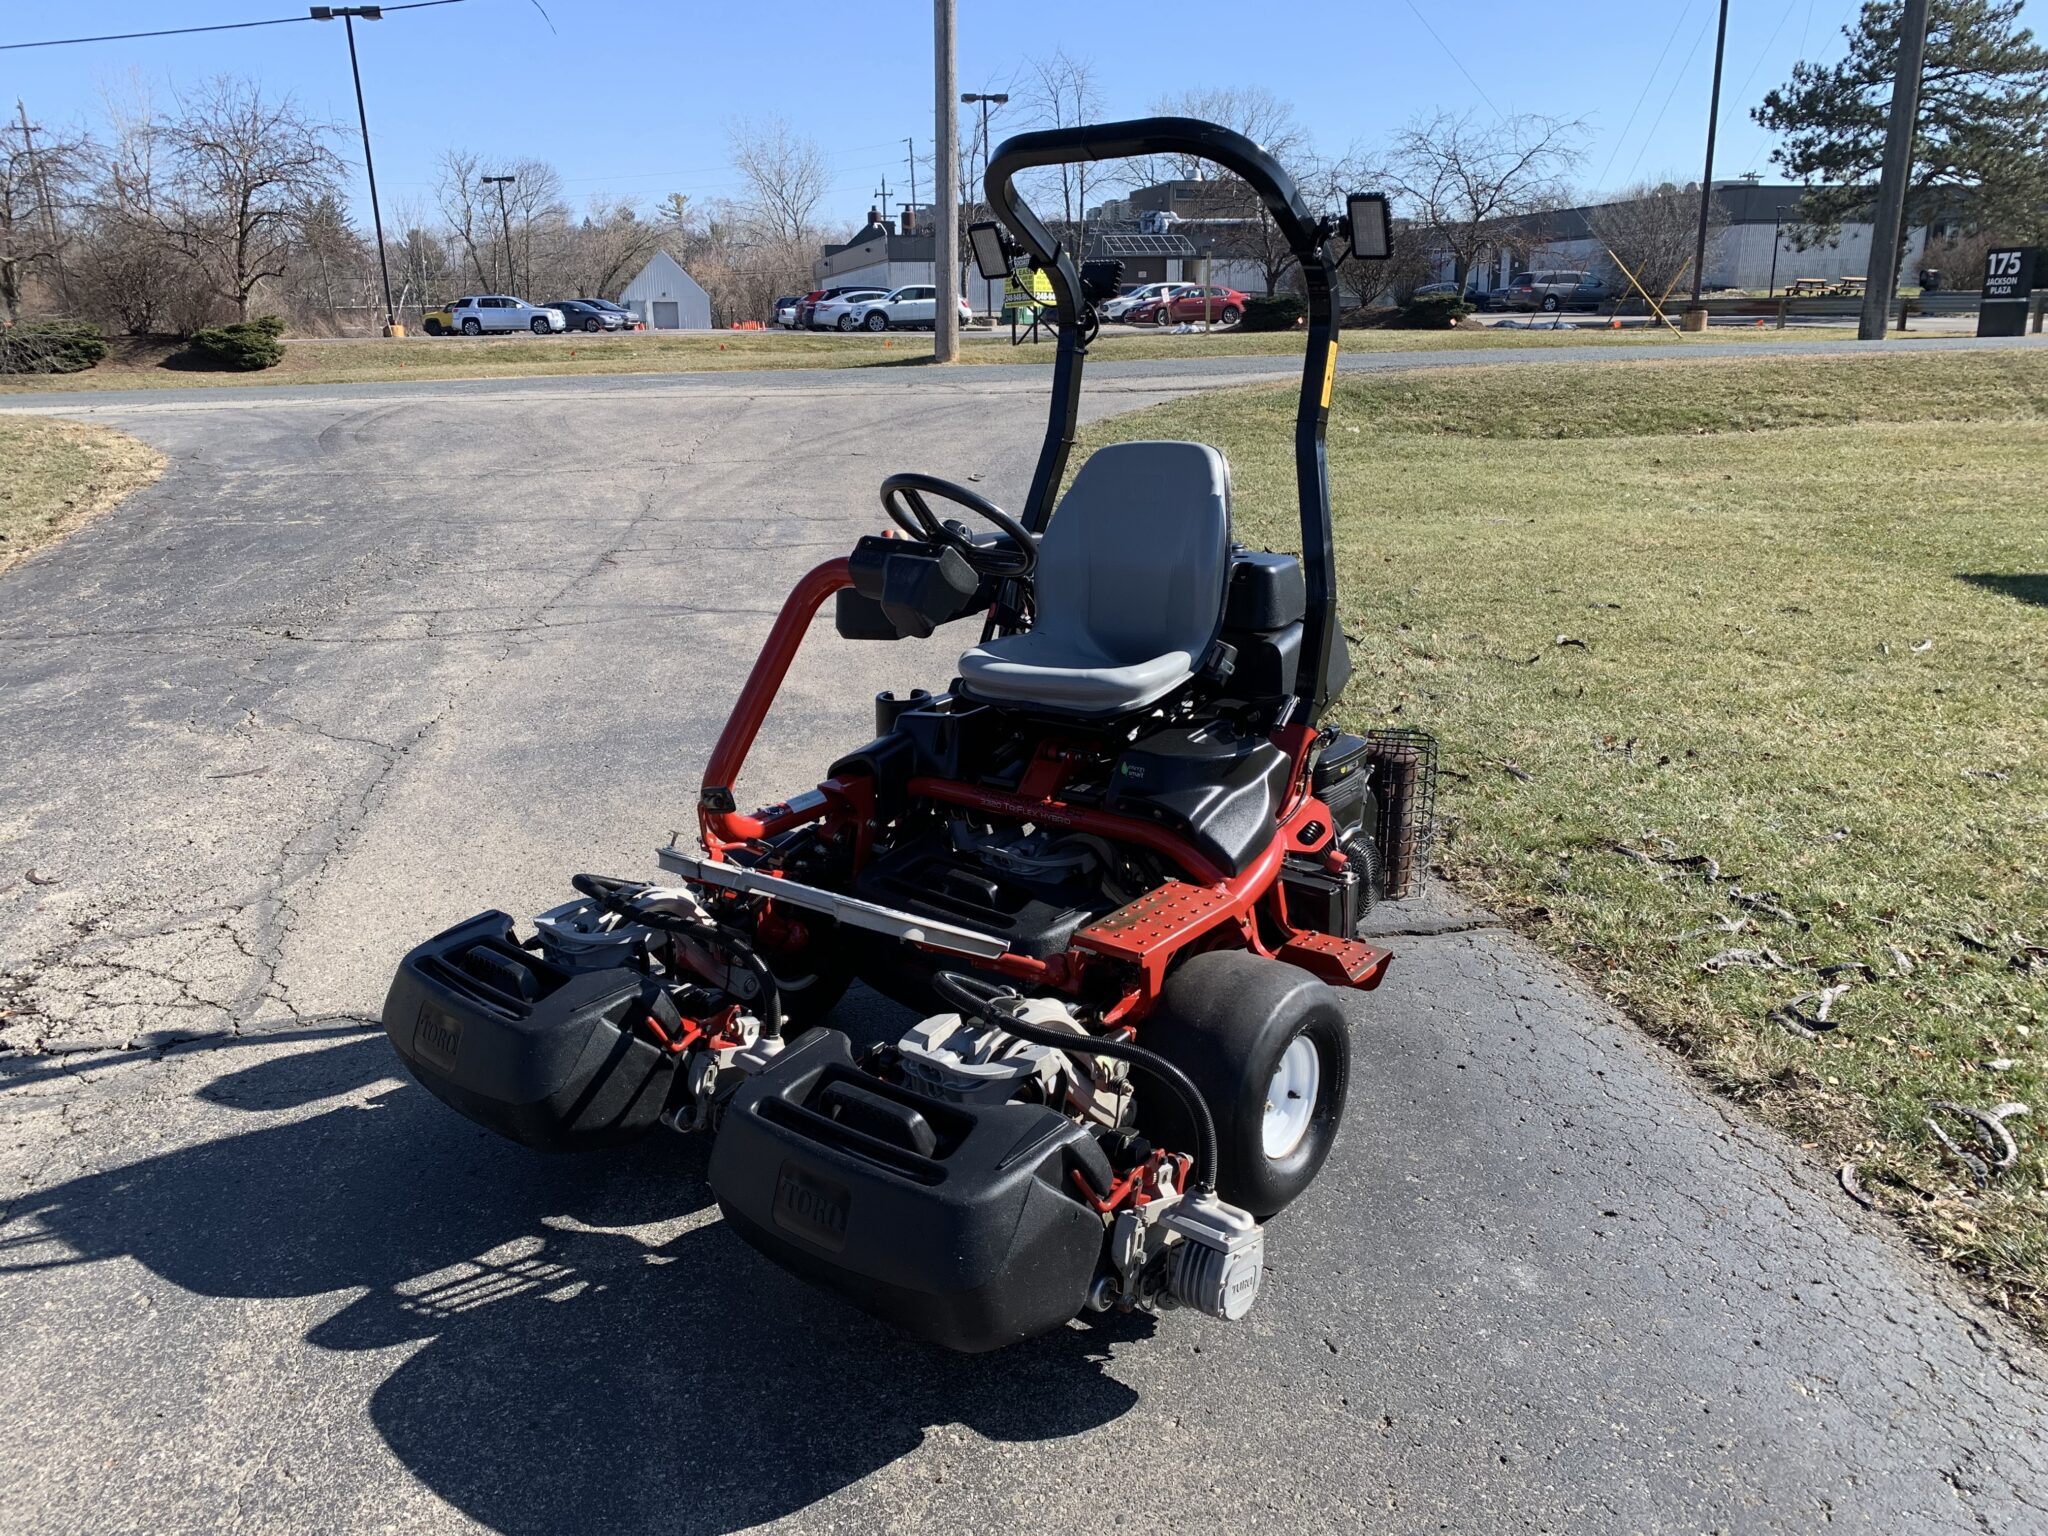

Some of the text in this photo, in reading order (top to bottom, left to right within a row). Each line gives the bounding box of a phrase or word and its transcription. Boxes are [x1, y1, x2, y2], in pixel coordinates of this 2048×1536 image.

[1988, 252, 2022, 275] 175
[1986, 277, 2018, 286] JACKSON
[1990, 286, 2012, 295] PLAZA
[1040, 812, 1071, 825] HYBRID
[419, 1015, 459, 1054] TORO
[780, 1176, 848, 1231] TORO
